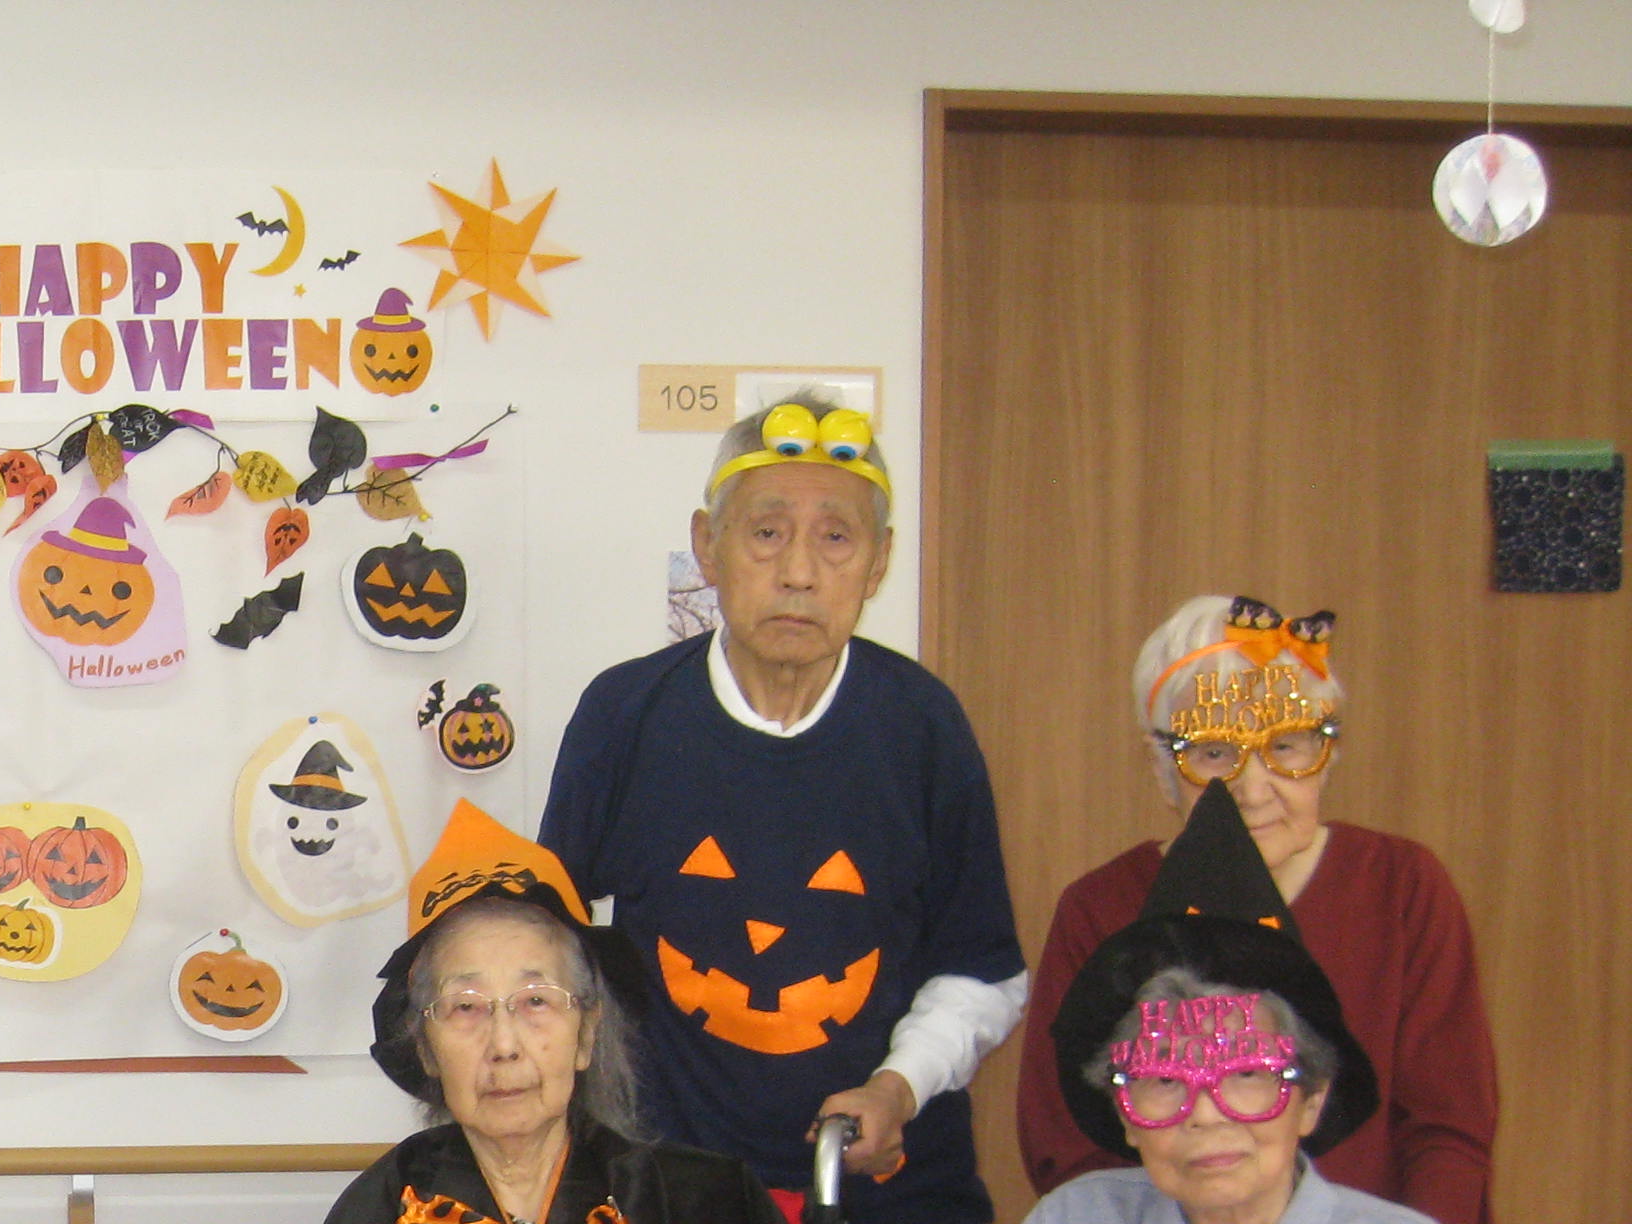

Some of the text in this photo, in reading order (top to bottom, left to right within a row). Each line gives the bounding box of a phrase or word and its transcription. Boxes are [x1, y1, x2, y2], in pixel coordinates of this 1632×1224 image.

[660, 385, 718, 411] 105
[68, 648, 185, 679] Halloween
[1195, 664, 1301, 705] HAPPY
[1171, 698, 1334, 734] HALLOWEEN
[1139, 993, 1261, 1037] HAPPY
[1109, 1031, 1295, 1067] HALLOWEEN
